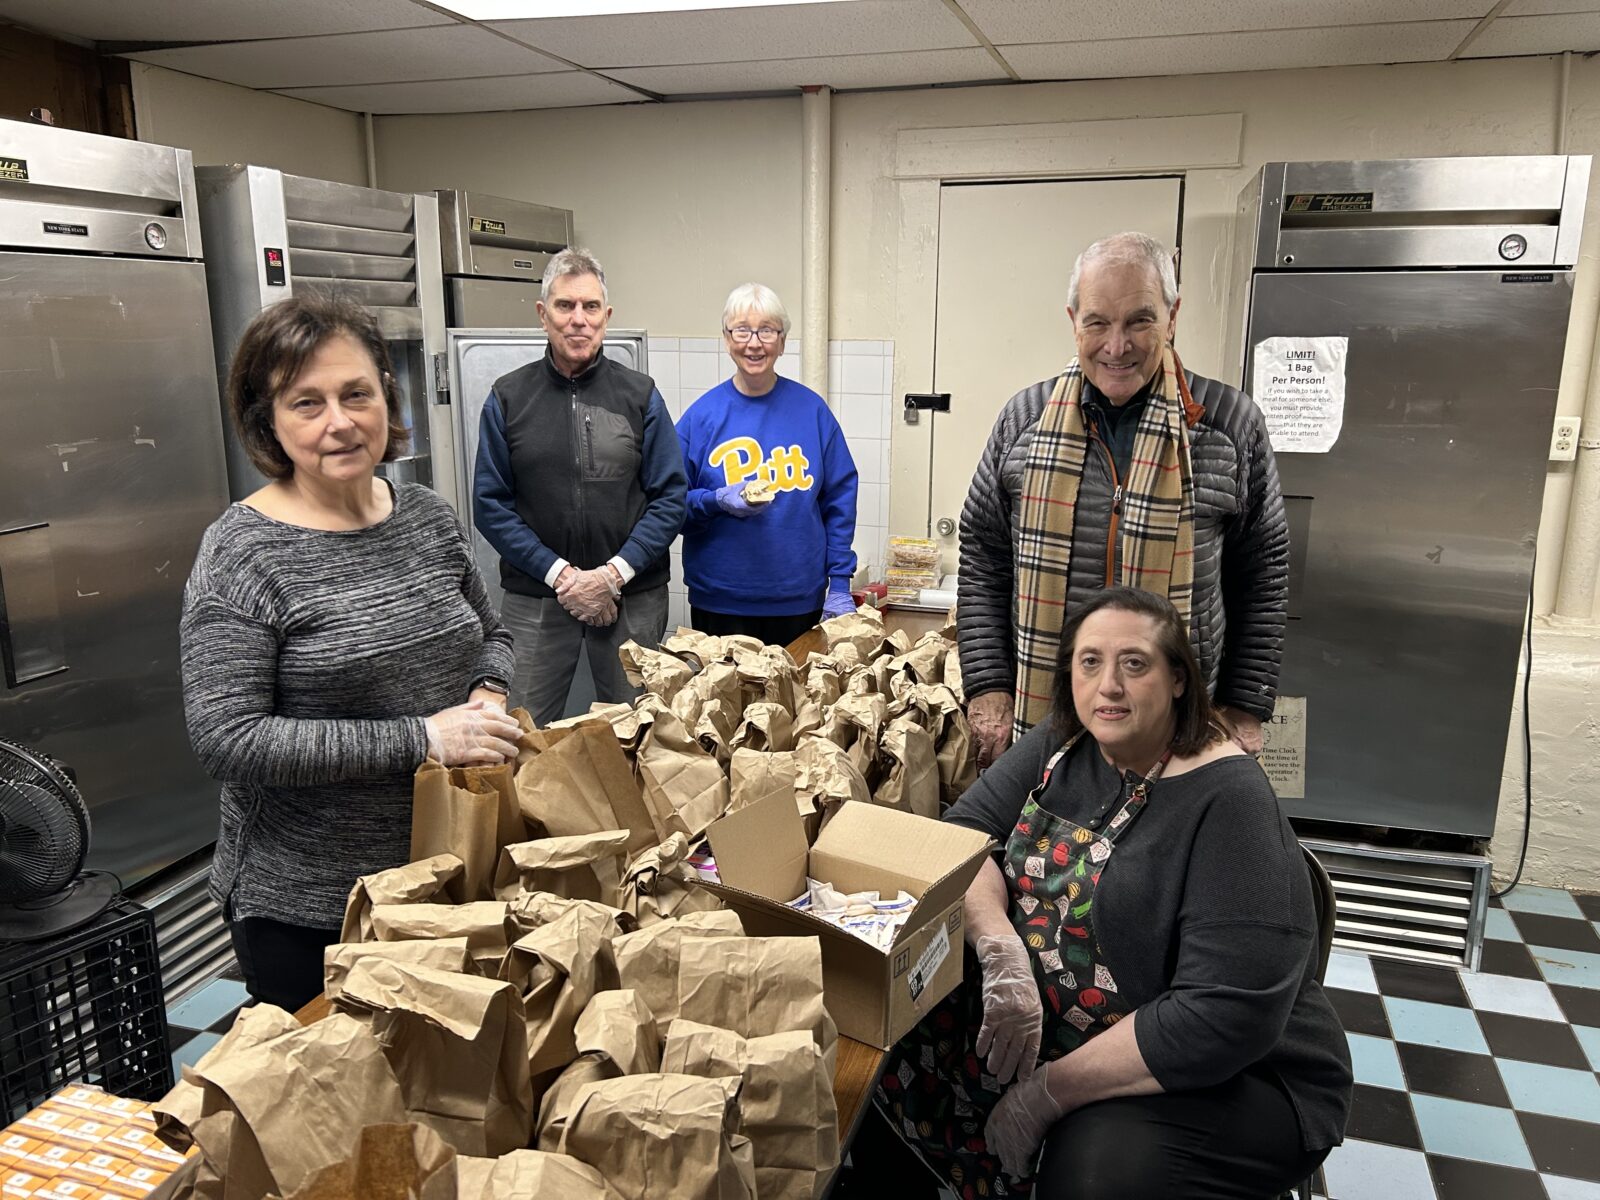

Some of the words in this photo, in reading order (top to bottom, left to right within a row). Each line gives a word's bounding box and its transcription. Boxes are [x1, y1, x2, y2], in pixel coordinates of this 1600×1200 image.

[1286, 351, 1315, 359] LIMIT!
[1296, 364, 1312, 373] Bag
[1272, 376, 1287, 384] Per
[1290, 376, 1326, 384] Person!
[708, 436, 815, 494] Pitt
